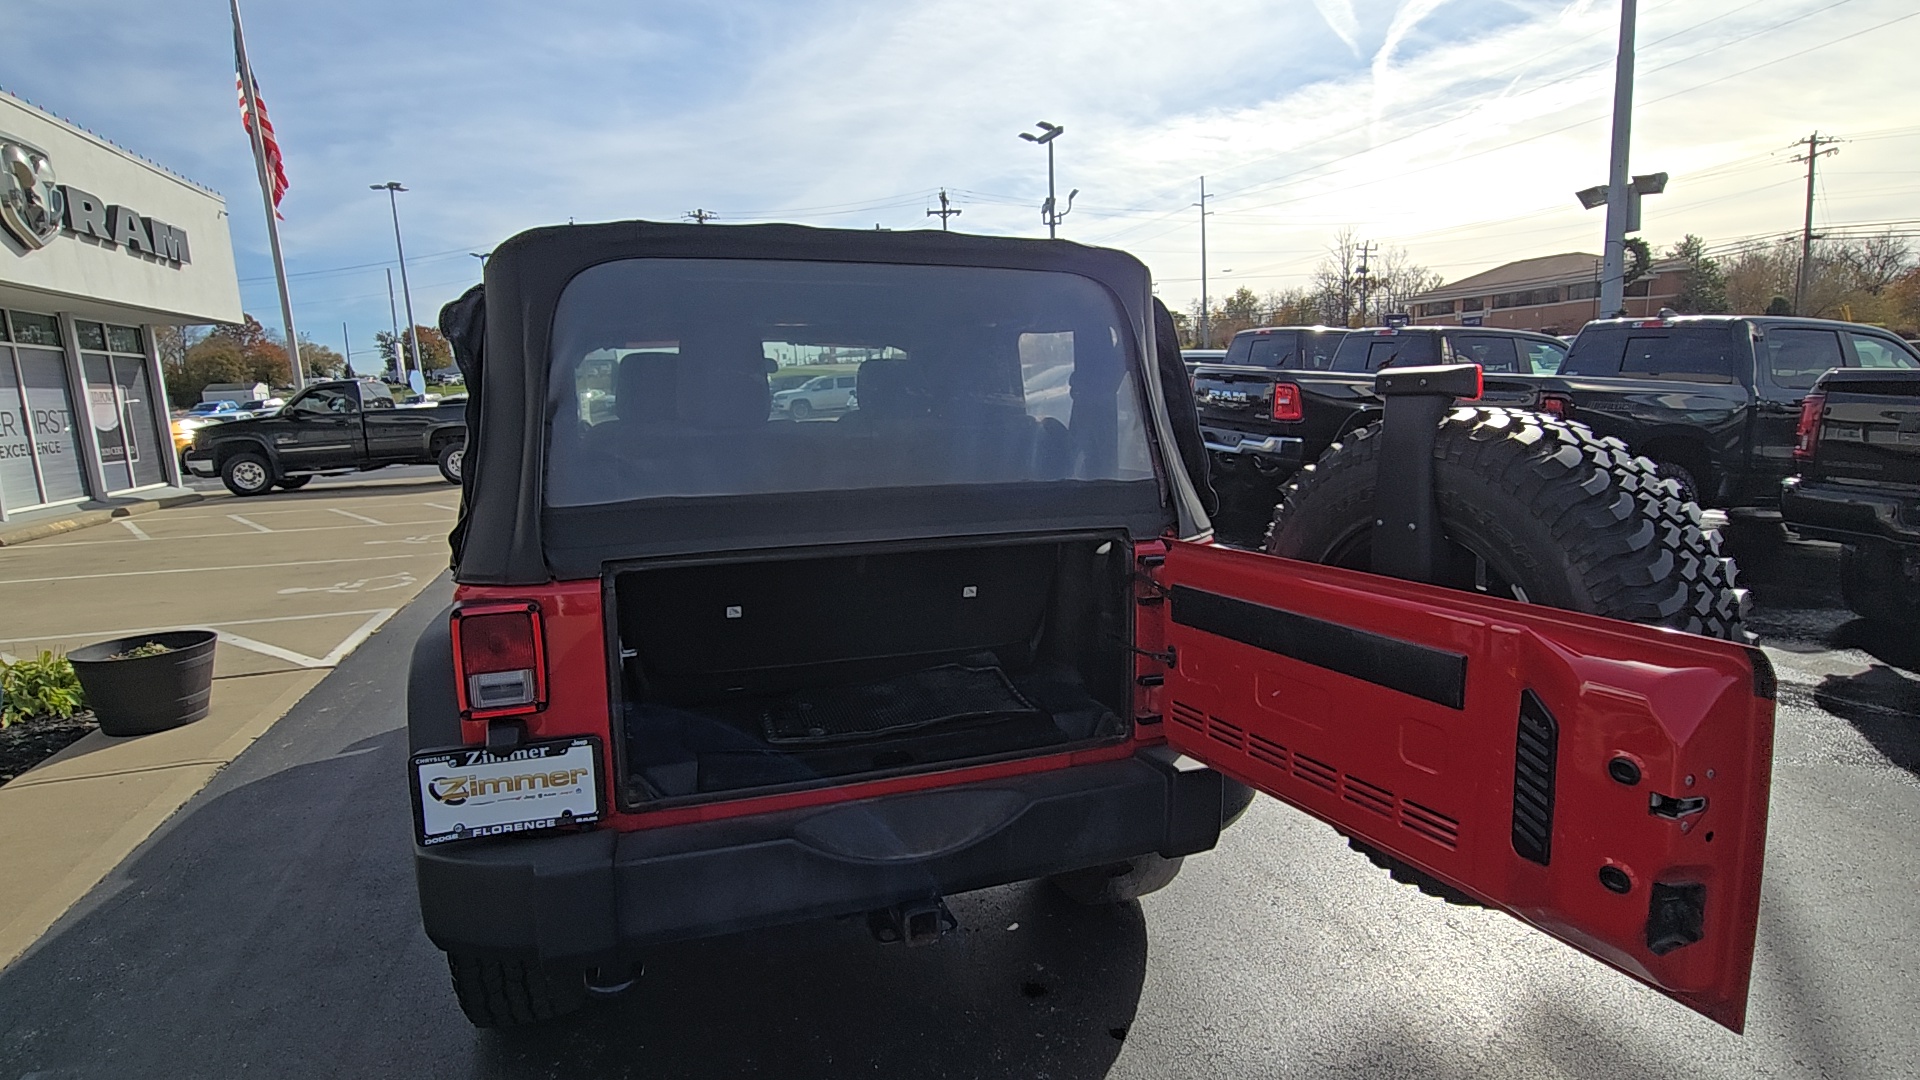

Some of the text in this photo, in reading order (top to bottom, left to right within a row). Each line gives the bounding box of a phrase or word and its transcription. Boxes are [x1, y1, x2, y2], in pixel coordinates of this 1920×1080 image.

[59, 185, 192, 265] RAM
[1208, 389, 1247, 403] RAM
[0, 441, 62, 459] EXCELENCE
[415, 755, 451, 765] CHRYSLER
[439, 767, 588, 800] Zimmer
[472, 818, 556, 837] FLORENCE
[424, 833, 459, 846] DODGE
